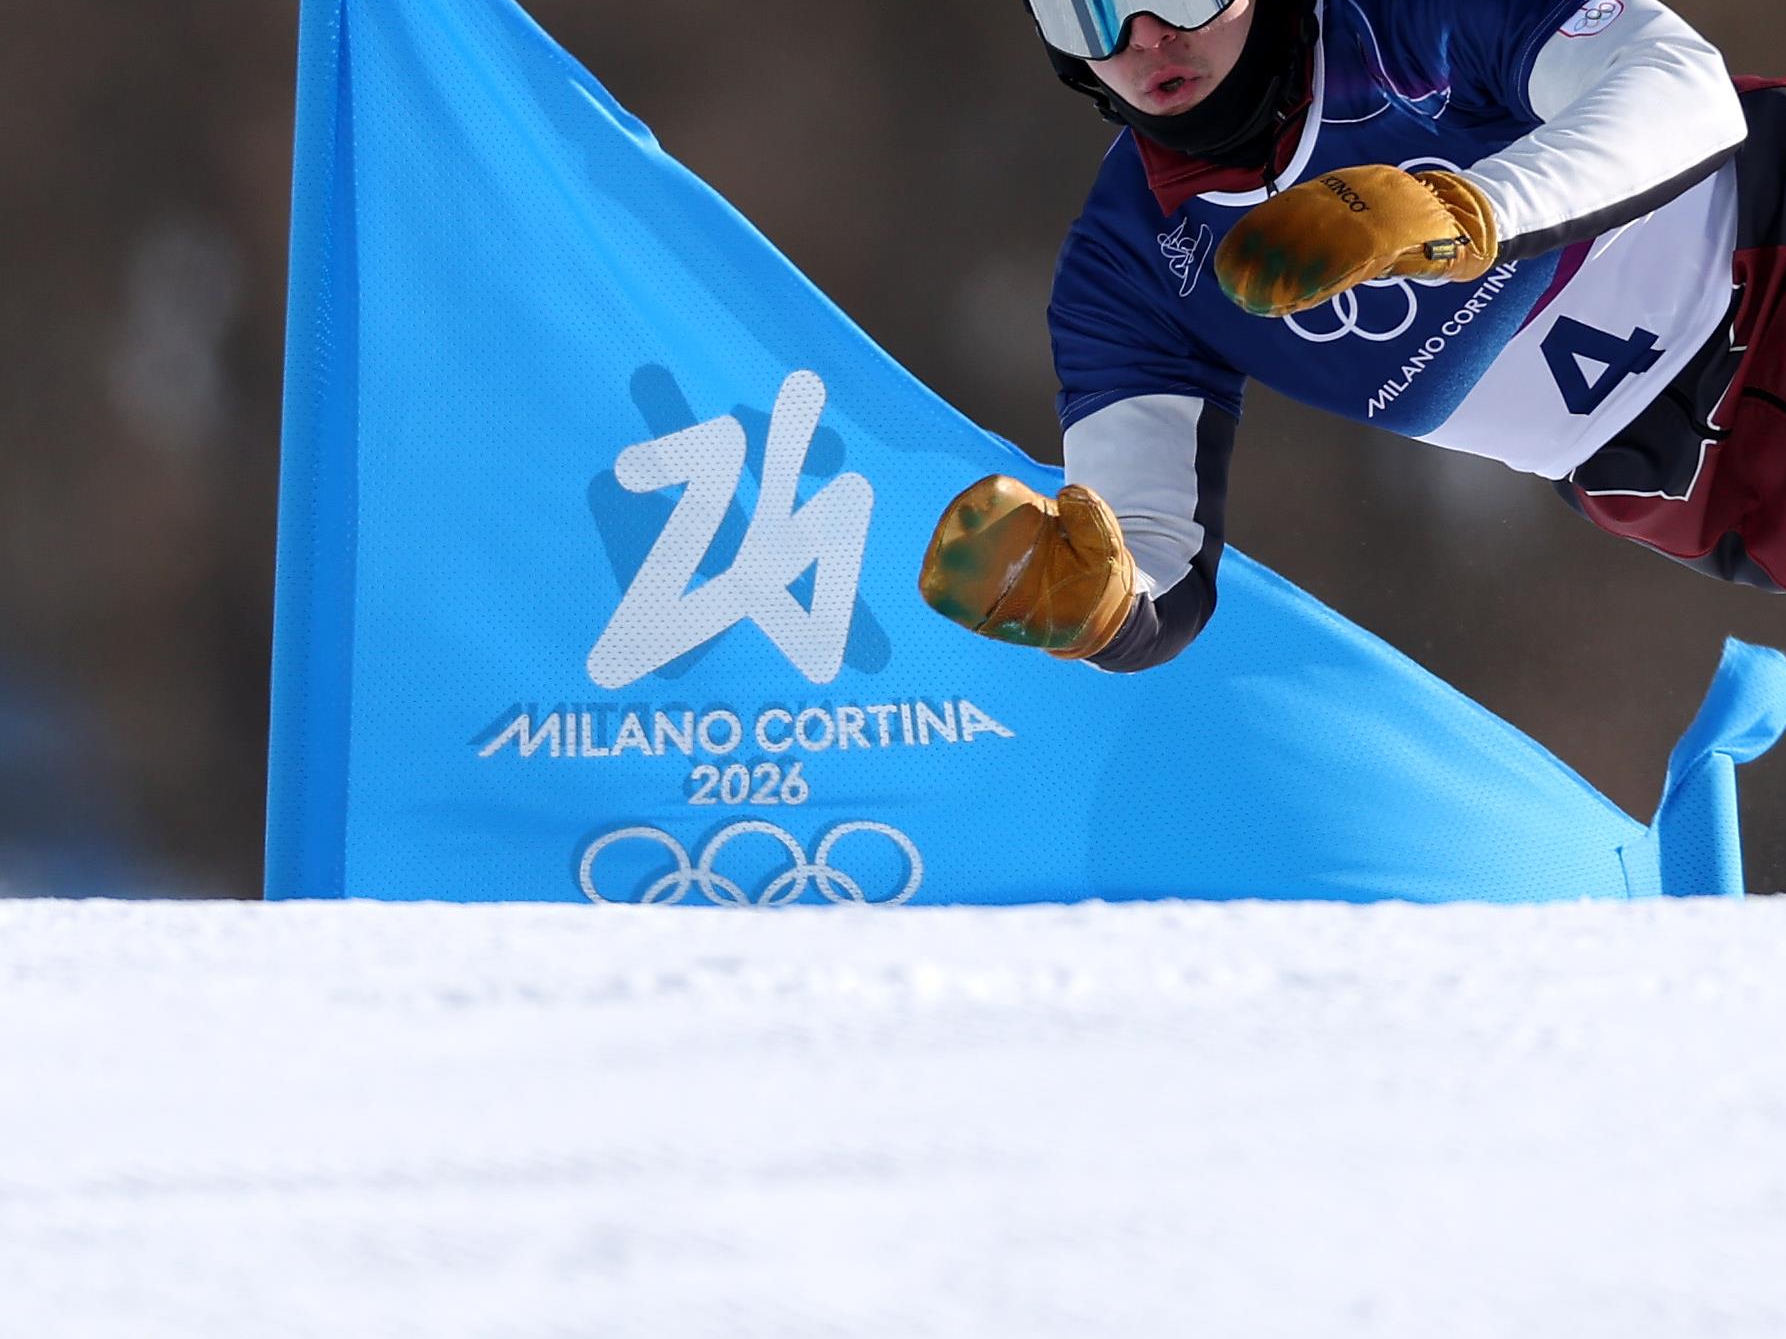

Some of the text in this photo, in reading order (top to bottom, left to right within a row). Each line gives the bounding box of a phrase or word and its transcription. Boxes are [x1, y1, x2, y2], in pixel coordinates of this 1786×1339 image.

[1320, 175, 1367, 213] KINCO
[1368, 336, 1445, 418] MILANO
[1541, 315, 1667, 416] 4
[478, 700, 1016, 758] MILANO CORTINA
[688, 762, 810, 805] 2026
